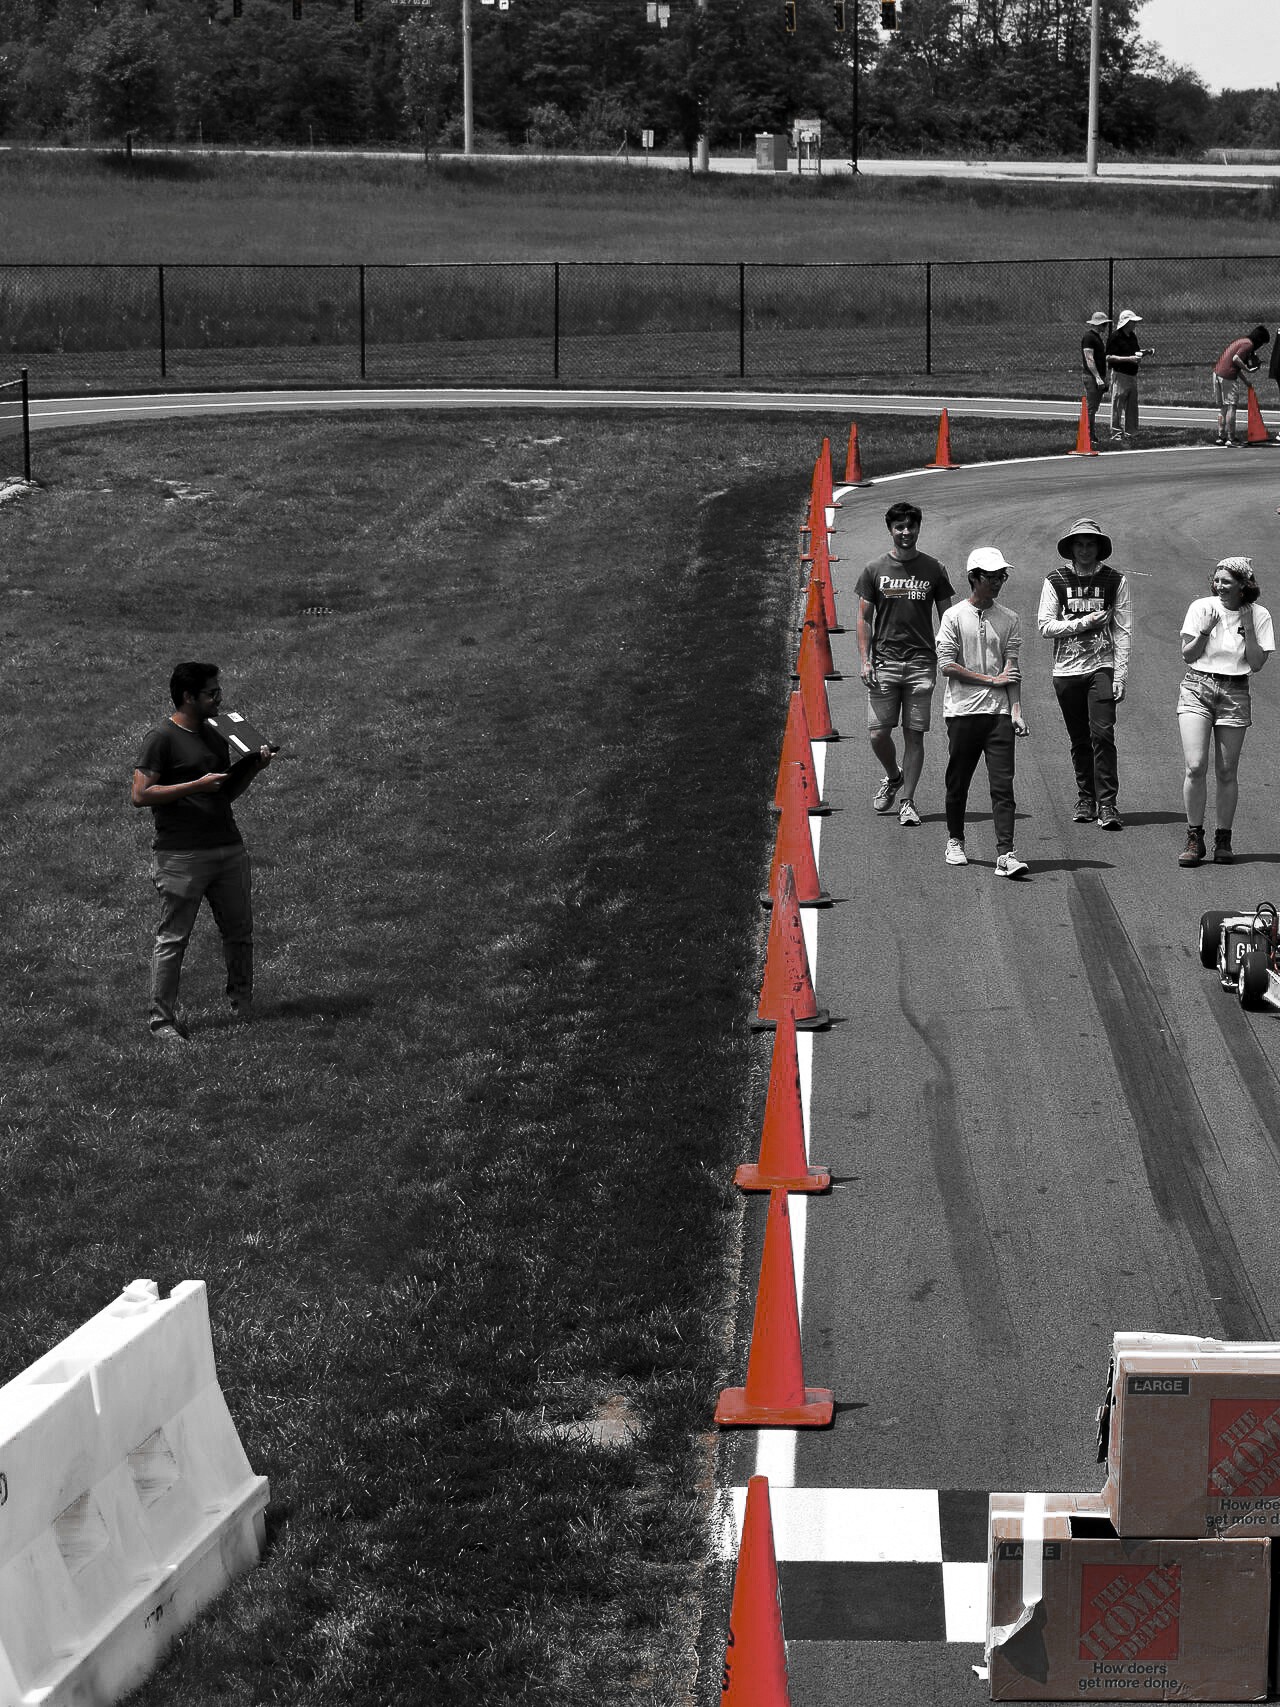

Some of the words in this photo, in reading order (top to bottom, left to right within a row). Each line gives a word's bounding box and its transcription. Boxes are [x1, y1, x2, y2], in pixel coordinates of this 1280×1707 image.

[879, 575, 931, 591] Purdue
[908, 591, 927, 601] 1869
[1066, 586, 1105, 598] HIGH
[1134, 1379, 1183, 1392] LARGE
[1217, 1408, 1261, 1449] THE
[1220, 1499, 1252, 1510] How
[1206, 1514, 1229, 1528] get
[1232, 1516, 1267, 1525] more
[1005, 1545, 1055, 1557] LAE
[1090, 1574, 1133, 1612] THE
[1080, 1564, 1182, 1661] HOME
[1119, 1599, 1179, 1660] DEPOT
[1093, 1662, 1124, 1674] How
[1127, 1662, 1167, 1674] doers
[1078, 1678, 1102, 1691] get
[1104, 1680, 1140, 1689] more
